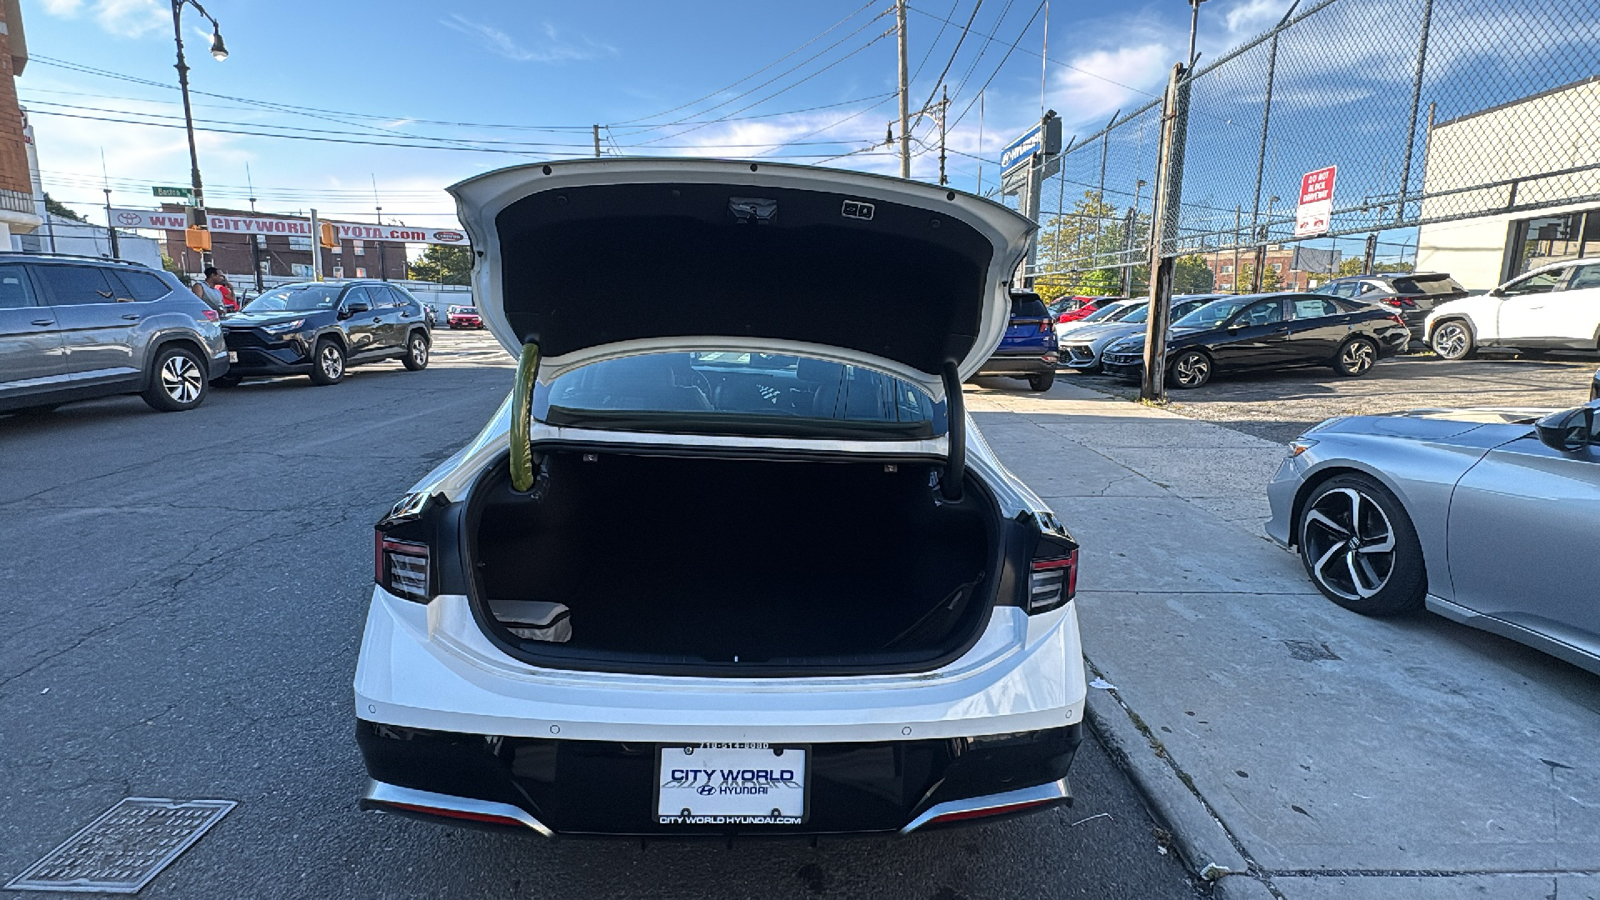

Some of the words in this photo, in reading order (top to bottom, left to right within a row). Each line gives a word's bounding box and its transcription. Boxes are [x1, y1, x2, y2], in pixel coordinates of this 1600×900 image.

[1308, 174, 1317, 184] DO
[1318, 171, 1329, 182] NOT
[671, 769, 717, 781] CITY
[720, 769, 794, 781] WORLD
[719, 786, 768, 795] HYUNDAI
[659, 816, 684, 824] CITY
[685, 816, 725, 824] WORLD
